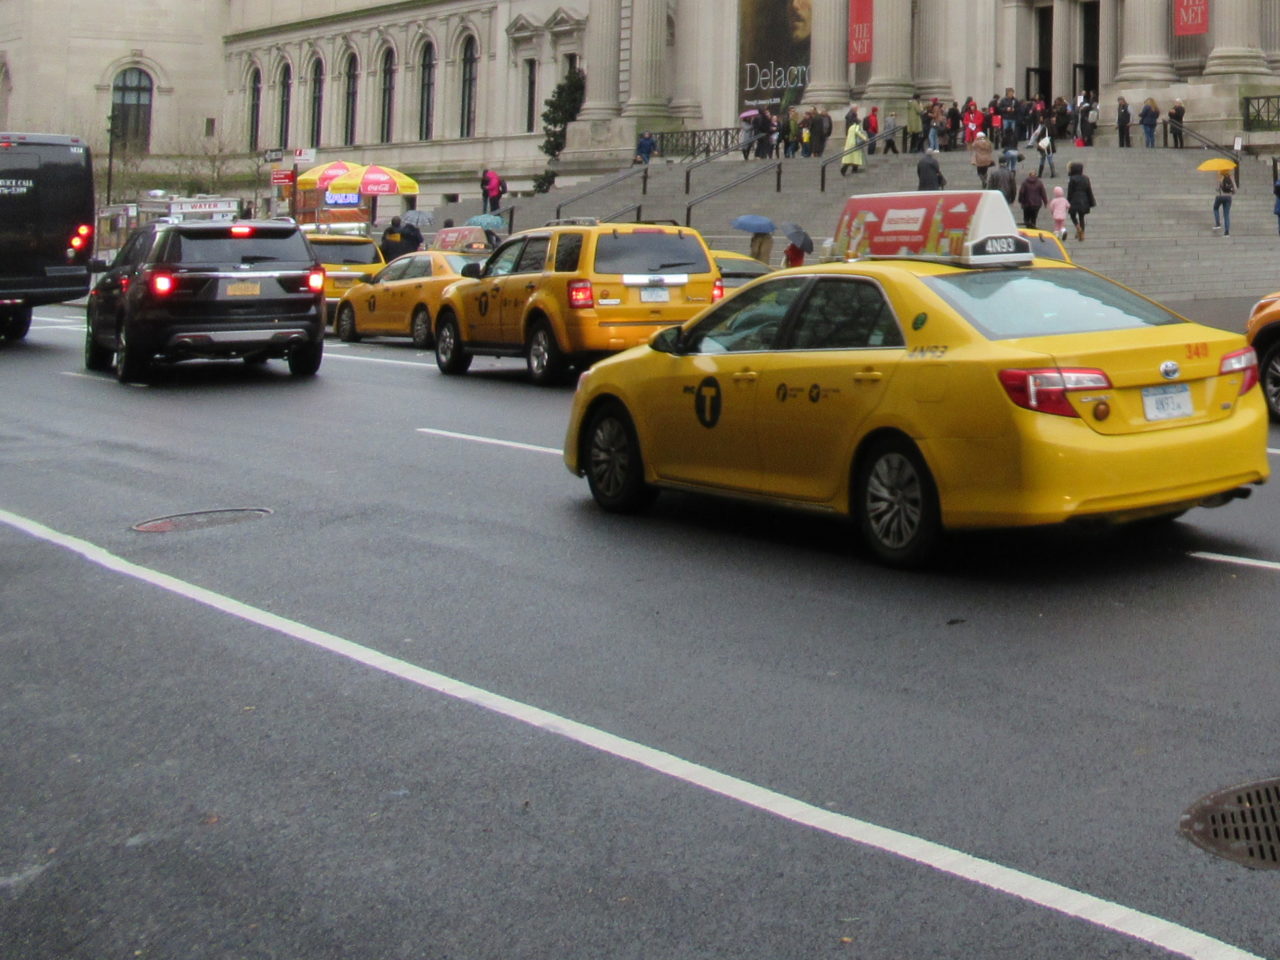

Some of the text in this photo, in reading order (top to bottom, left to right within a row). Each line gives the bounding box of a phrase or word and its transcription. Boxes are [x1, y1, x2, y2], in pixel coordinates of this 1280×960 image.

[1180, 6, 1204, 26] MET
[191, 202, 219, 210] WATER
[985, 238, 1015, 254] 4N93
[908, 344, 949, 359] 4N93
